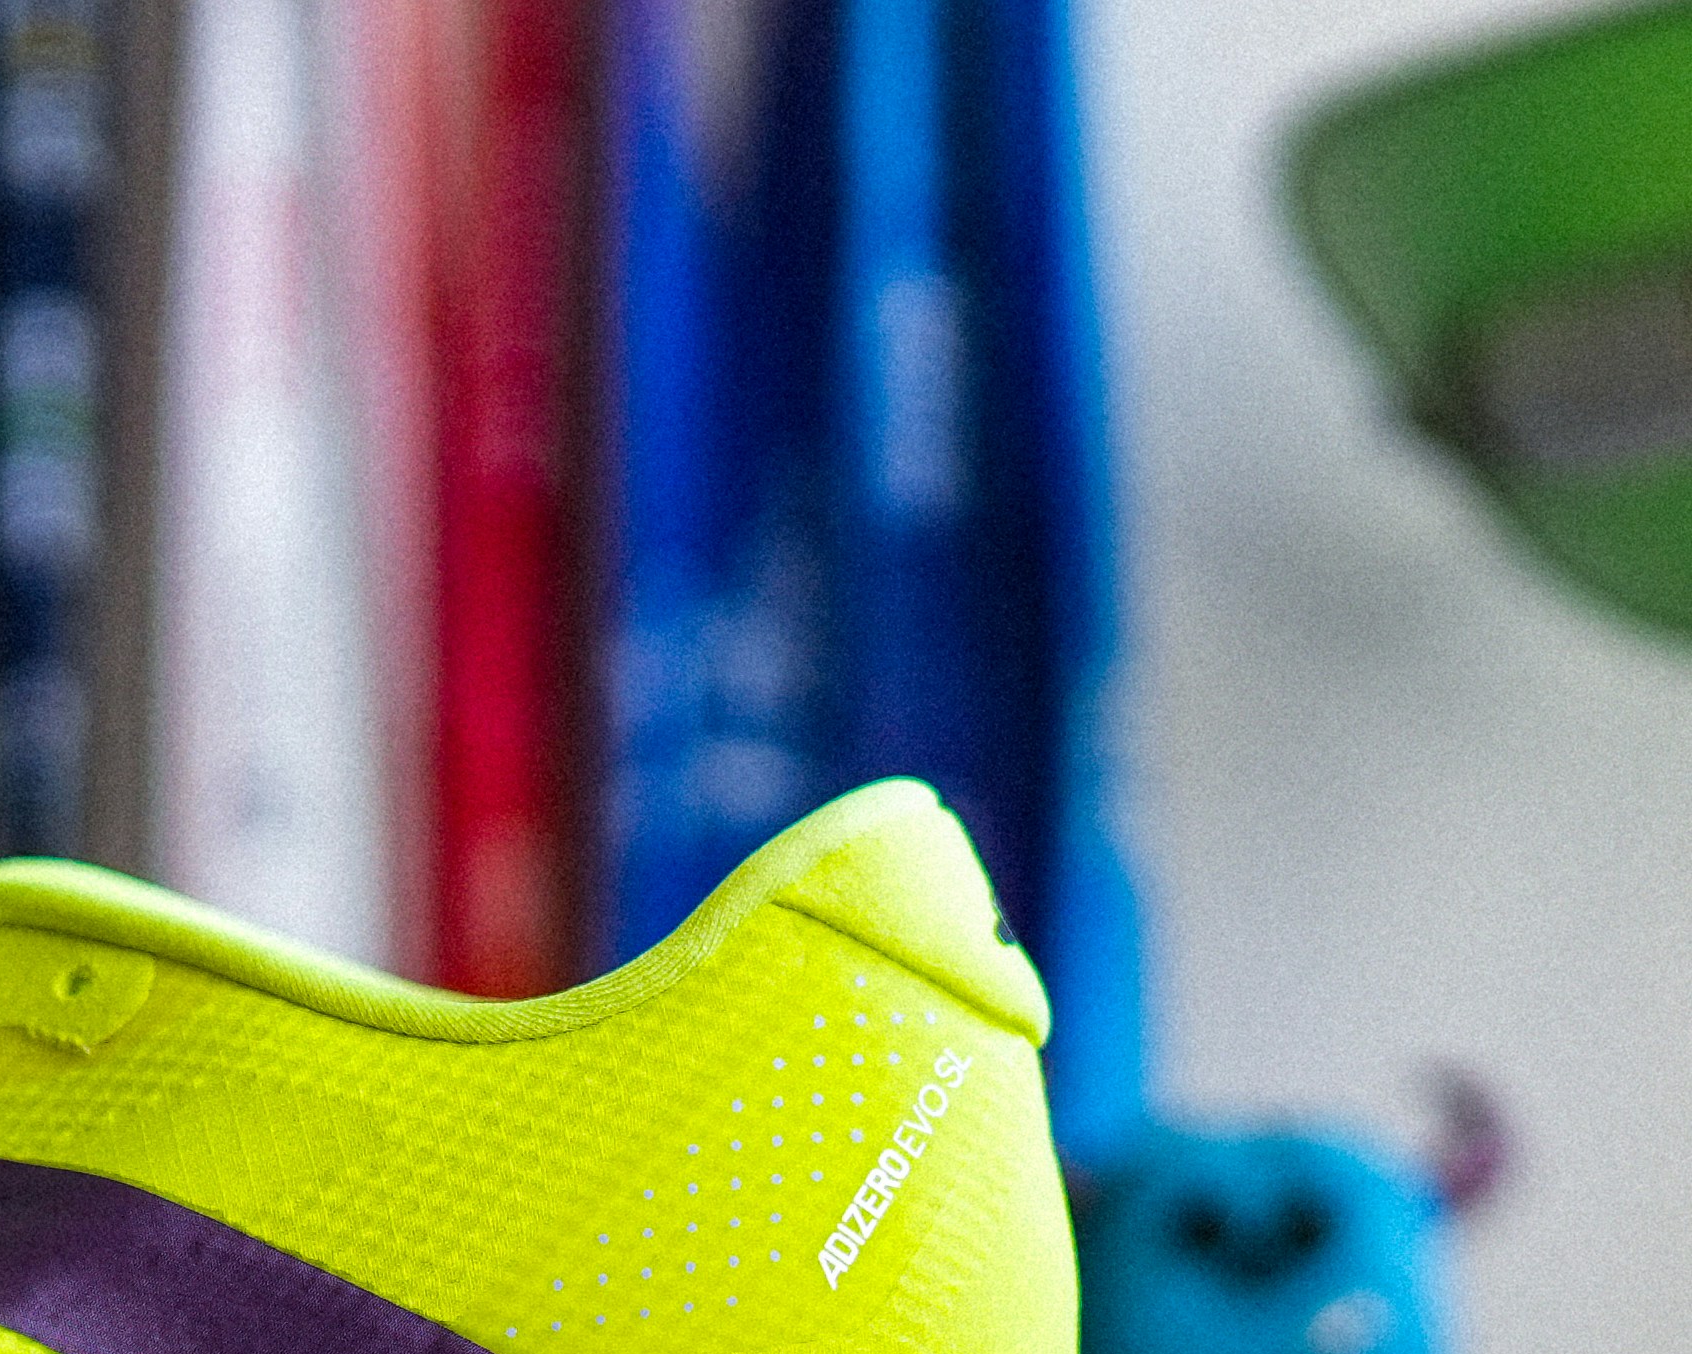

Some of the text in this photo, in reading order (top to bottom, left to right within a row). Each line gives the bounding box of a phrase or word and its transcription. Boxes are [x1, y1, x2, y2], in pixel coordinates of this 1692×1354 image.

[817, 1048, 974, 1291] ADIZERO EVO SL
